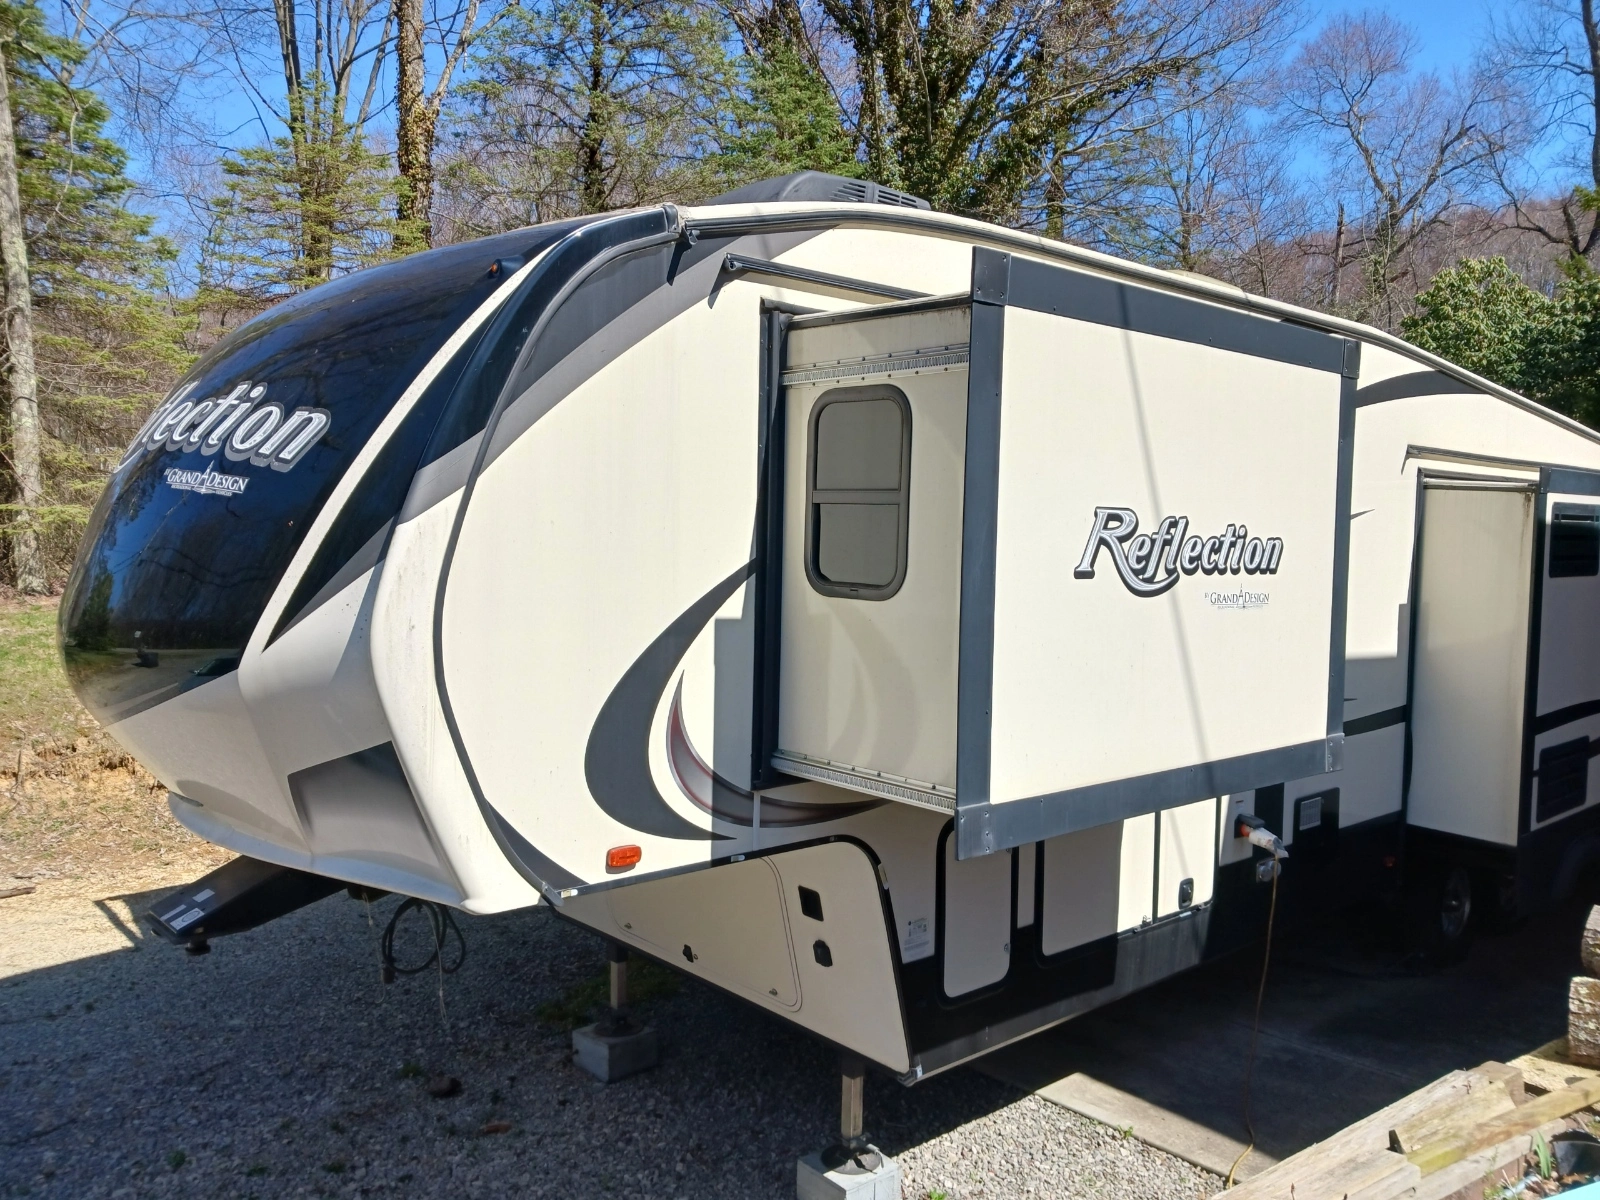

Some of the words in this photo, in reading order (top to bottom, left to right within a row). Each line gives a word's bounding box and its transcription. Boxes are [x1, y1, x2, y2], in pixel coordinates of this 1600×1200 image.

[113, 380, 331, 473] flection
[167, 468, 202, 484] GRAND
[207, 472, 250, 492] DESIGN
[1074, 506, 1284, 598] Reflection
[1210, 592, 1238, 604] GRAND
[1244, 591, 1270, 603] DESIGN
